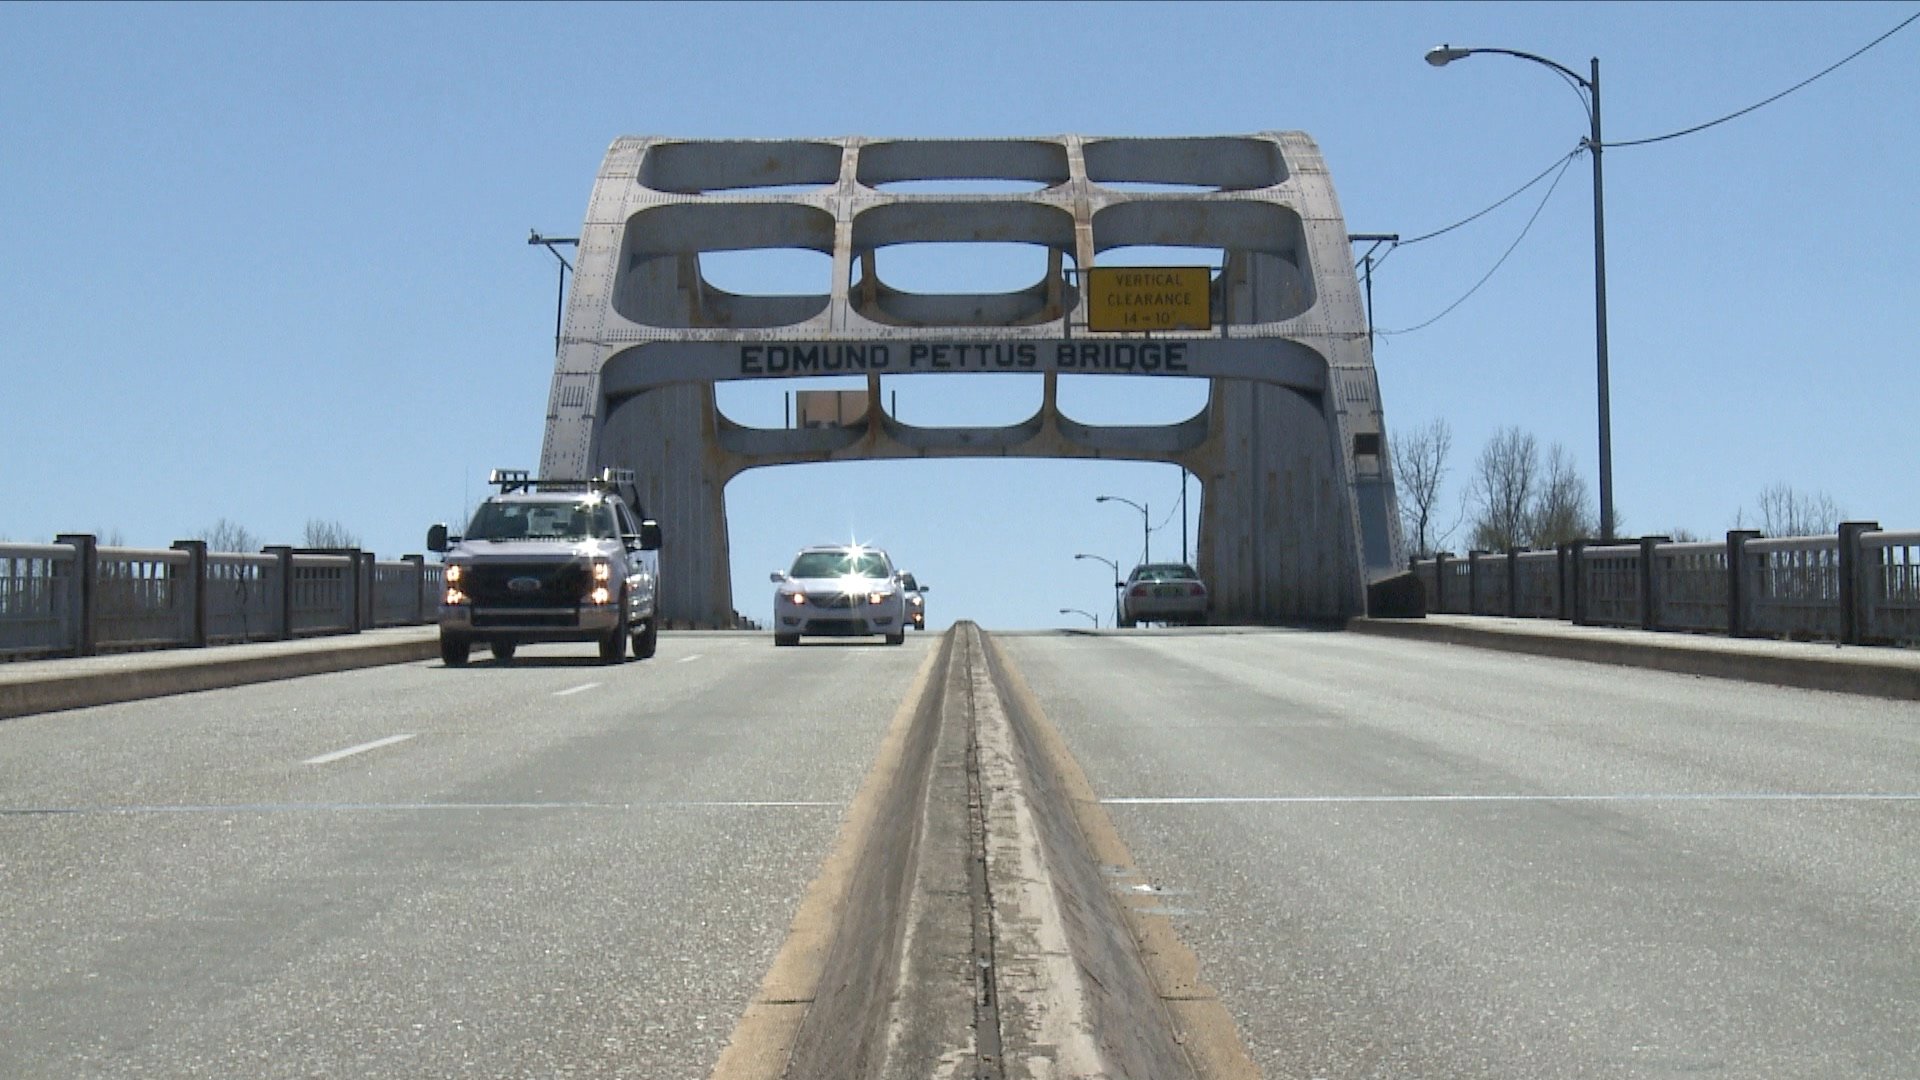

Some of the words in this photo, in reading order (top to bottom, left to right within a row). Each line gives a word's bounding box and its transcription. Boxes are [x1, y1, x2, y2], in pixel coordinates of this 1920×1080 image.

[1115, 273, 1183, 287] VERTICAL
[1107, 292, 1192, 306] CLEARANCE
[741, 345, 889, 373] EDMUND
[910, 344, 1036, 368] PETTUS
[1057, 343, 1188, 371] BRIDGE
